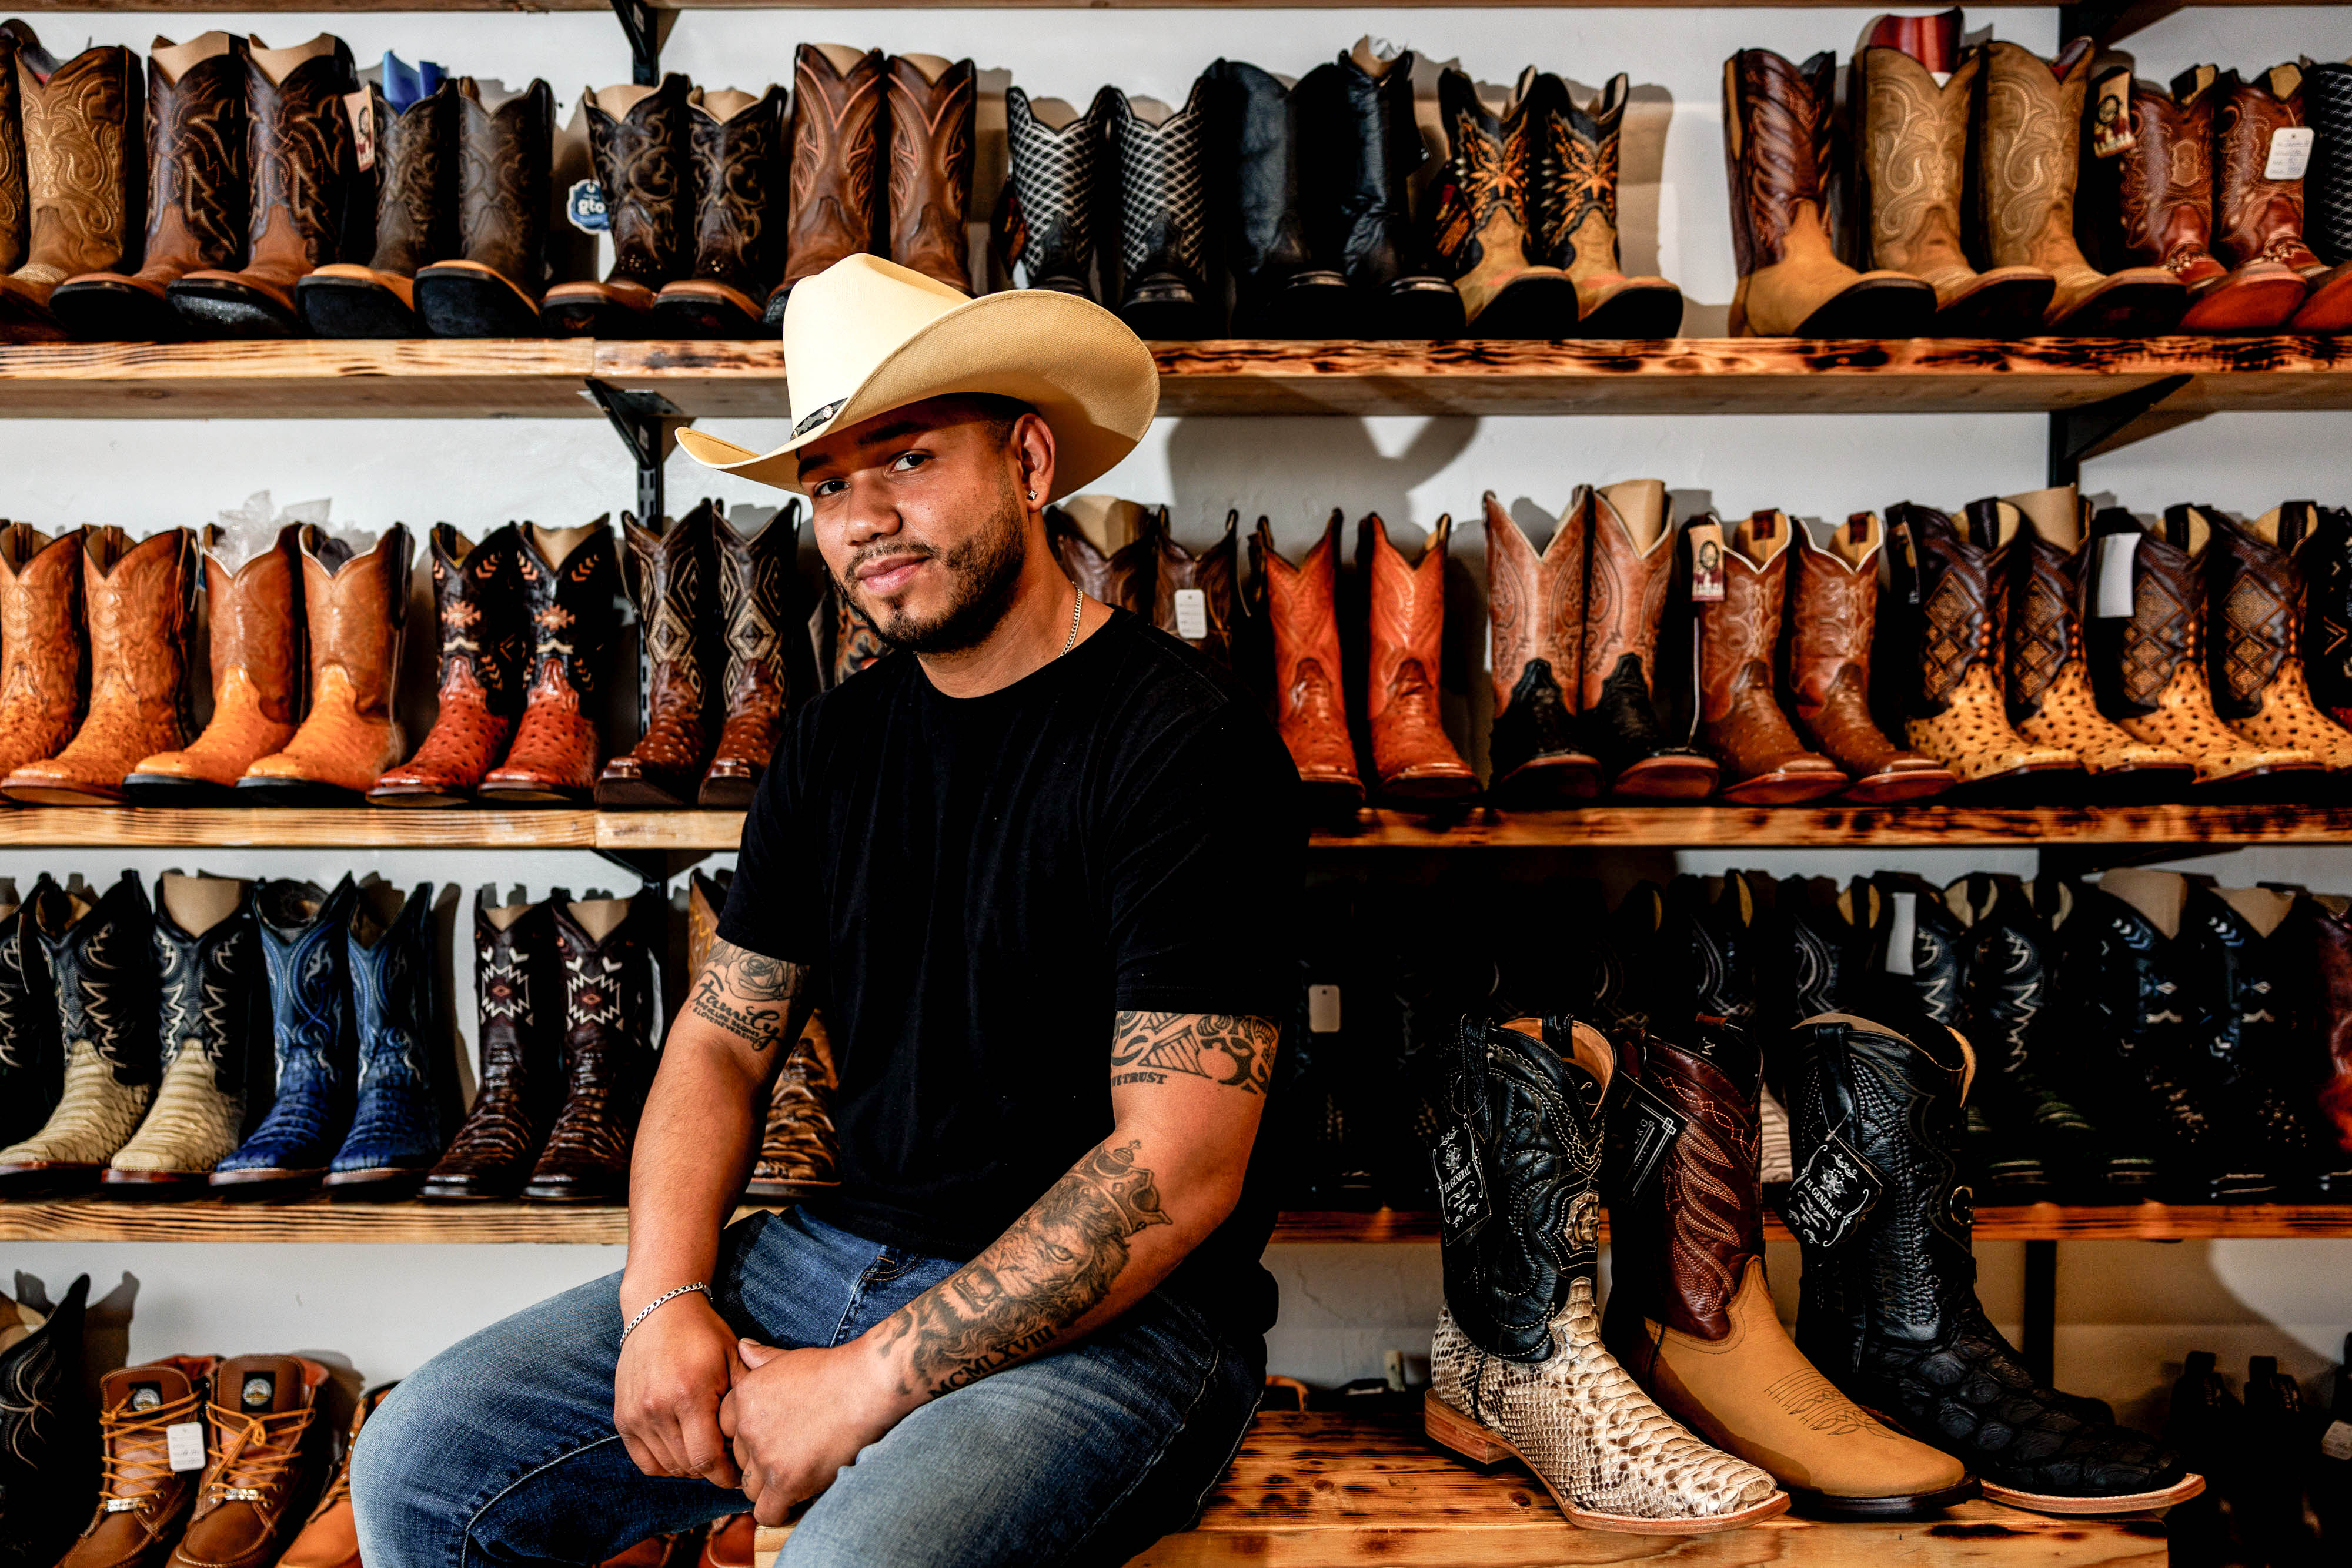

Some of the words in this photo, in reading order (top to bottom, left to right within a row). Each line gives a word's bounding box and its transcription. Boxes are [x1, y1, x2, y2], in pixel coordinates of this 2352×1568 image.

[578, 199, 606, 216] gto
[693, 969, 781, 1051] Family
[1122, 1072, 1167, 1084] TRUST
[1444, 1182, 1451, 1193] EL
[1450, 1166, 1471, 1188] GENERAL
[1804, 1178, 1813, 1191] EL
[1811, 1186, 1838, 1219] GENERAL
